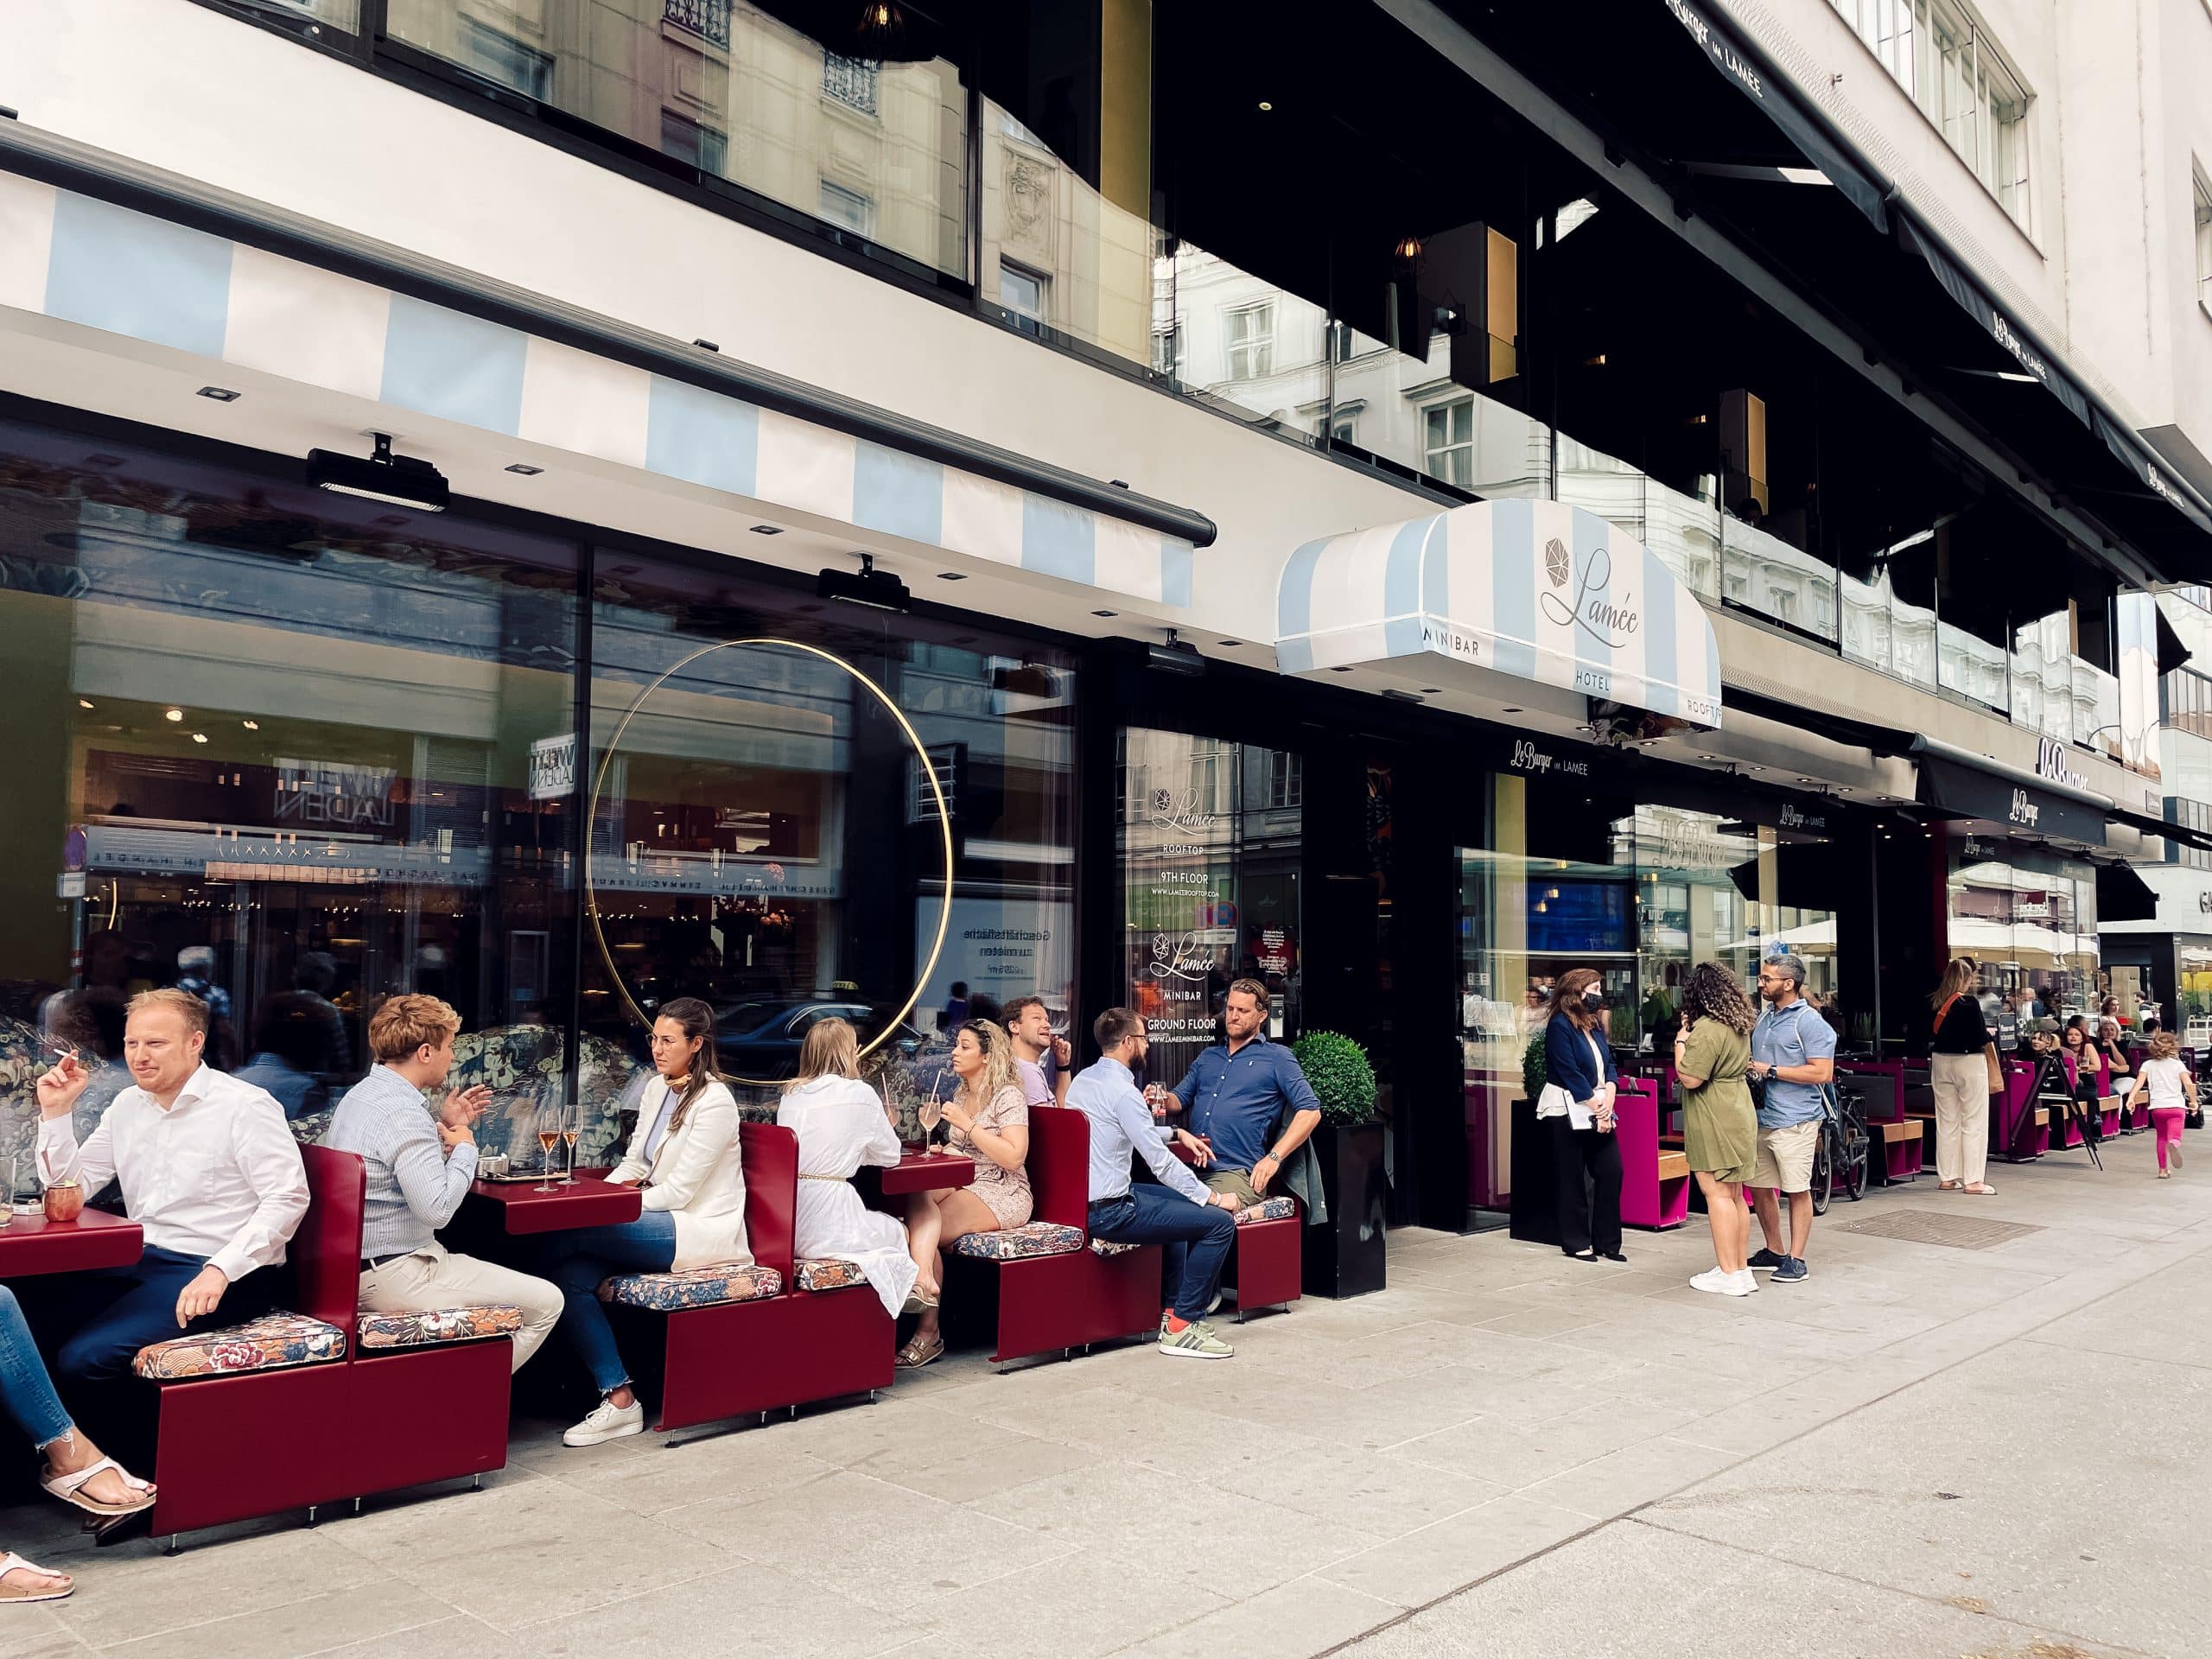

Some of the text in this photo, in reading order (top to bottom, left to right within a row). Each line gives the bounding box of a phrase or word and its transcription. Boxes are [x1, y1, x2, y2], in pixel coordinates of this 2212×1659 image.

[1541, 548, 1639, 649] Lamée
[1576, 671, 1611, 691] HOTEL
[1523, 741, 1553, 774] Burger
[1152, 787, 1217, 836] Lamée
[1162, 843, 1205, 855] ROOFTOP
[1160, 871, 1209, 885] 9TH FLOOR
[1149, 931, 1216, 982] Lamée
[1163, 991, 1201, 1001] MINIBAR
[1147, 1018, 1217, 1031] GROUND FLOOR
